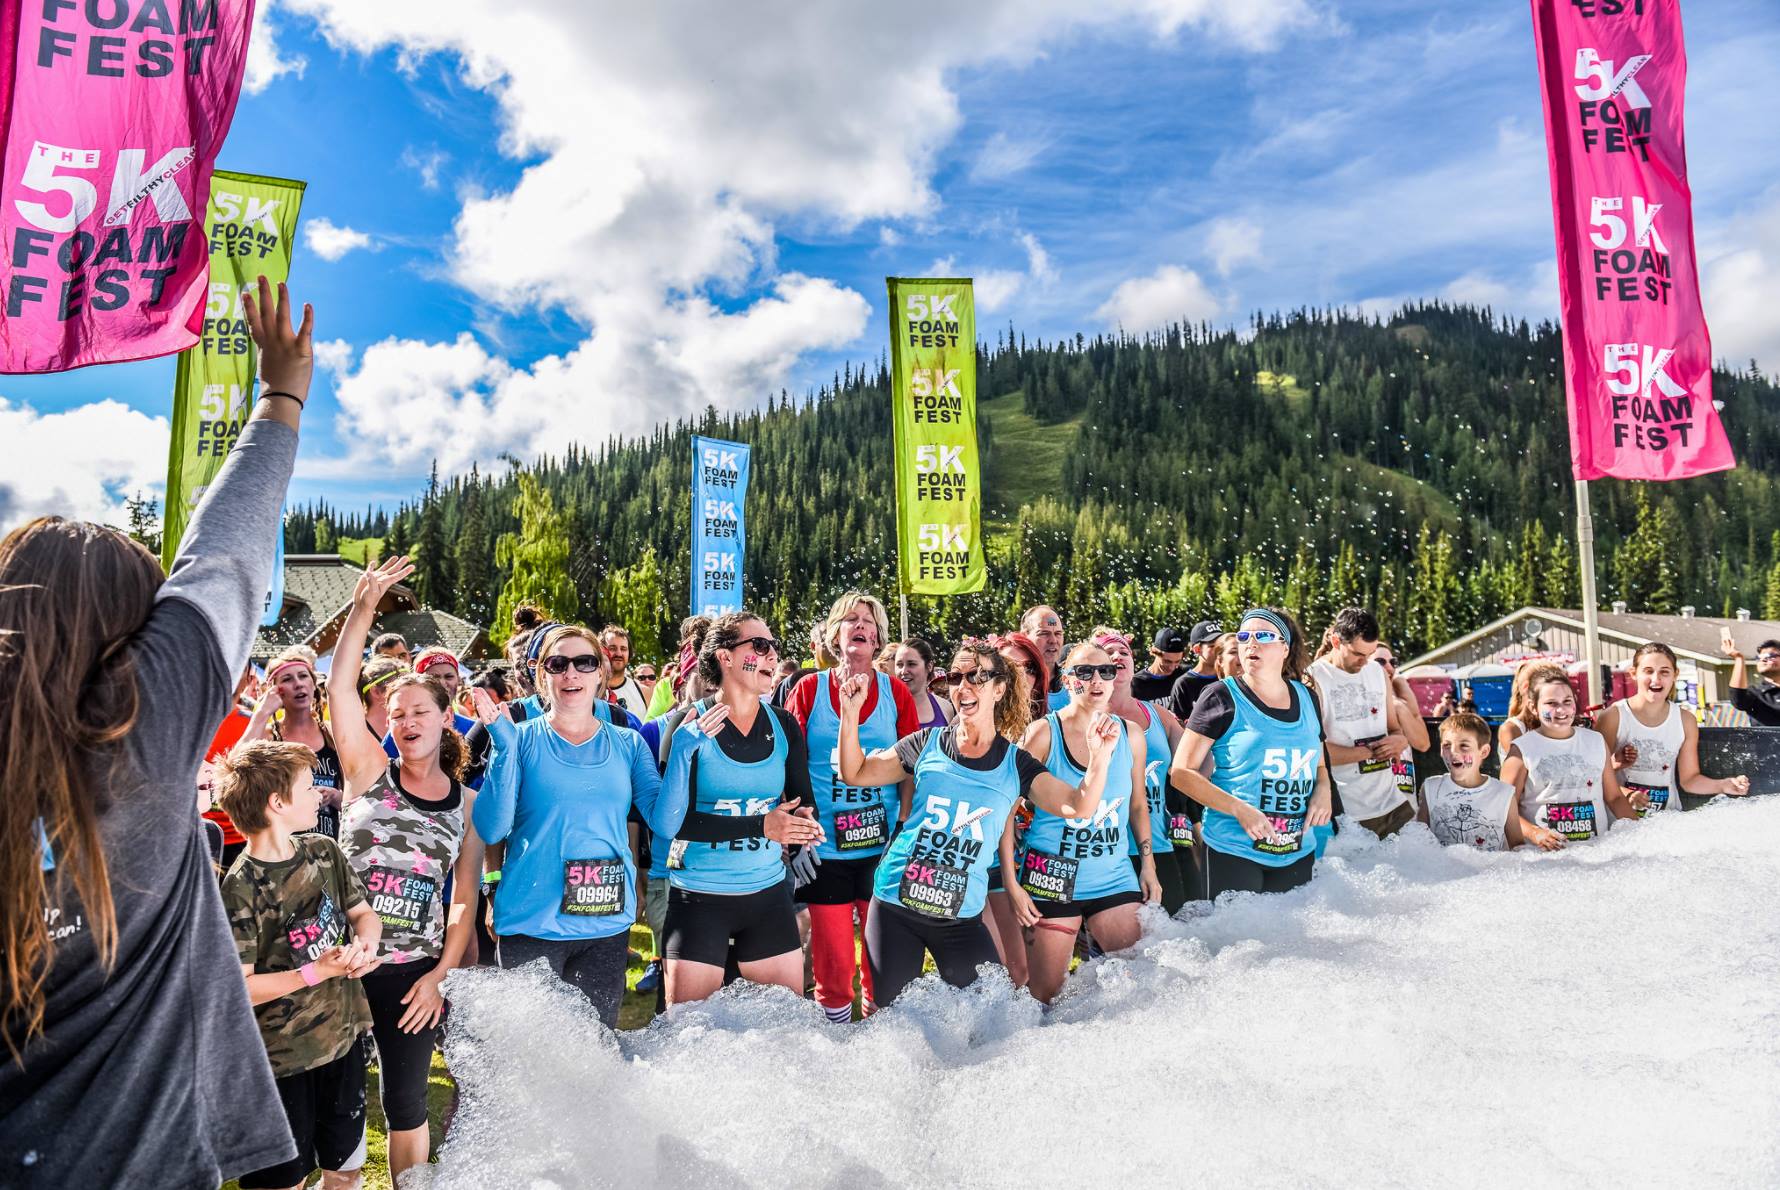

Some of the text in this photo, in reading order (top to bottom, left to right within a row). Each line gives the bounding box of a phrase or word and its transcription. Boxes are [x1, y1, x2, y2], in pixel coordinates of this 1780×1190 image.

[42, 0, 218, 35] FOAM
[37, 27, 216, 78] FEST
[1574, 48, 1653, 110] 5K
[1579, 100, 1651, 137] FOM
[1582, 127, 1650, 162] FET
[37, 145, 96, 164] THE
[14, 140, 197, 234] 5K
[106, 146, 197, 225] GETFILTHYCLEAN
[214, 191, 282, 237] 5K
[1589, 196, 1670, 254] 5K
[211, 223, 278, 248] FOAM
[12, 224, 189, 274] FOAM
[209, 240, 273, 259] FEST
[1593, 249, 1672, 279] FOAM
[6, 268, 178, 322] FEST
[1595, 276, 1672, 305] FEST
[906, 294, 958, 321] 5K
[204, 319, 248, 336] FOA
[909, 320, 959, 334] FOAM
[203, 337, 248, 355] FES
[909, 334, 959, 348] FEST
[1604, 342, 1688, 398] 5K
[912, 368, 961, 397] 5K
[913, 395, 962, 410] FOAM
[1612, 395, 1692, 424] FOAM
[914, 410, 962, 424] FEST
[1614, 421, 1693, 451] FEST
[704, 449, 740, 471] 5K
[915, 445, 966, 473] 5K
[705, 466, 738, 480] FOAM
[917, 472, 966, 487] FOAM
[705, 477, 737, 489] FEST
[917, 487, 966, 502] FEST
[704, 499, 738, 521] 5K
[705, 518, 738, 530] FOAM
[705, 528, 737, 539] FEST
[918, 523, 969, 551] 5K
[704, 551, 735, 572] 5K
[919, 551, 970, 565] FOAM
[704, 570, 735, 582] FOAM
[919, 565, 970, 580] FEST
[704, 580, 735, 591] FEST
[1262, 748, 1318, 780] 5K
[832, 787, 881, 802] FEST
[1261, 779, 1312, 795] FOAM
[861, 807, 885, 820] FOAM
[924, 794, 994, 842] 5K
[1549, 806, 1575, 820] 5K
[1574, 805, 1595, 813] FOAM
[1574, 811, 1595, 819] FEST
[836, 813, 862, 831] 5K
[862, 814, 885, 826] FEST
[1557, 820, 1592, 833] 08458
[845, 824, 880, 842] 09205
[1062, 826, 1120, 843] FOAM
[917, 828, 983, 858] FOAM
[1059, 842, 1118, 858] FEST
[912, 843, 975, 872] FEST
[1026, 853, 1048, 874] 5K
[1048, 859, 1077, 873] FOAM
[568, 865, 602, 885] 5K
[602, 873, 625, 884] FEST
[603, 864, 625, 875] FOAM
[905, 863, 936, 886] 5K
[936, 870, 966, 885] FOAM
[1047, 866, 1075, 880] FEST
[368, 871, 406, 896] 5K
[405, 878, 434, 892] FOAM
[934, 879, 965, 893] FEST
[1029, 870, 1064, 893] 09333
[402, 887, 432, 902] FEST
[576, 885, 619, 903] 09964
[909, 883, 953, 907] 09963
[372, 894, 421, 919] 09215
[289, 919, 323, 949] 5K
[307, 916, 340, 961] 09217
